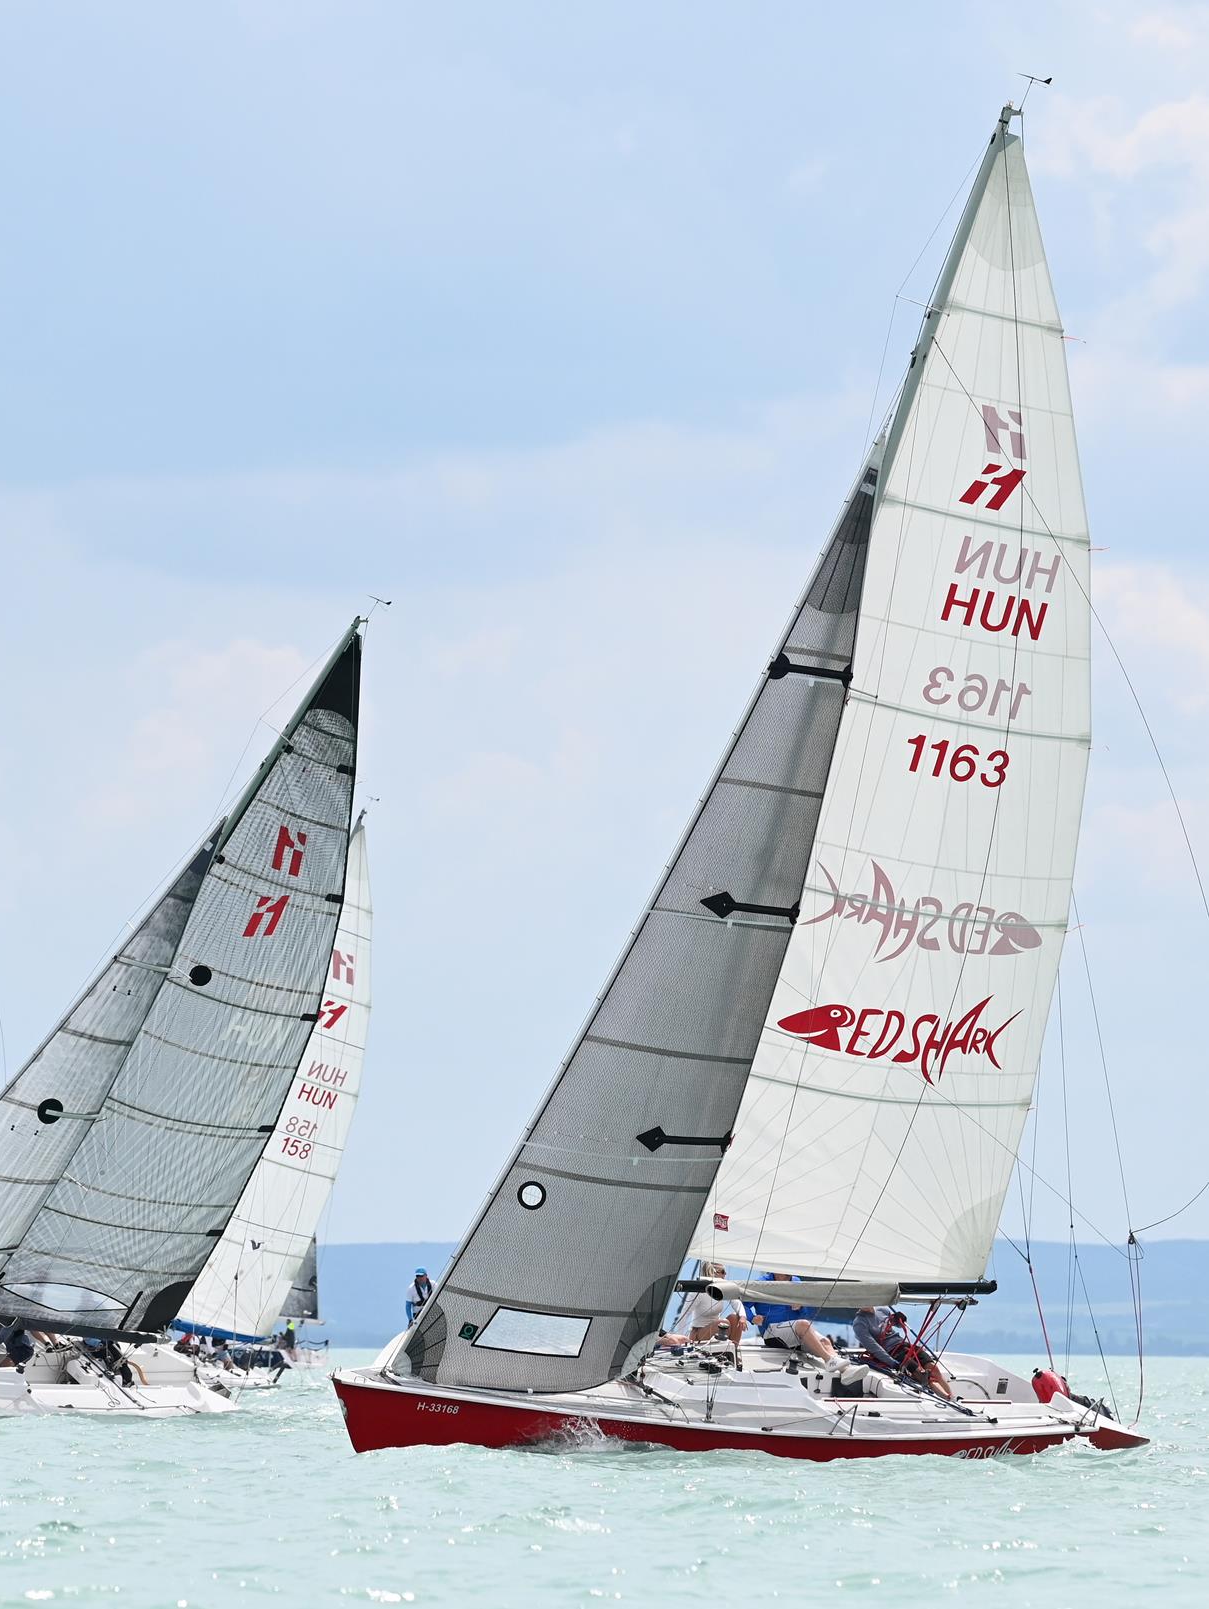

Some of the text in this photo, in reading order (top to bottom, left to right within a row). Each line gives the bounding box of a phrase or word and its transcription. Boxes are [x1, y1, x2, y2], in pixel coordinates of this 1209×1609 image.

[940, 583, 1048, 640] HUN
[907, 734, 1010, 788] 1163
[297, 1083, 338, 1110] HUN
[281, 1137, 312, 1160] 158
[416, 1401, 460, 1415] H-33168
